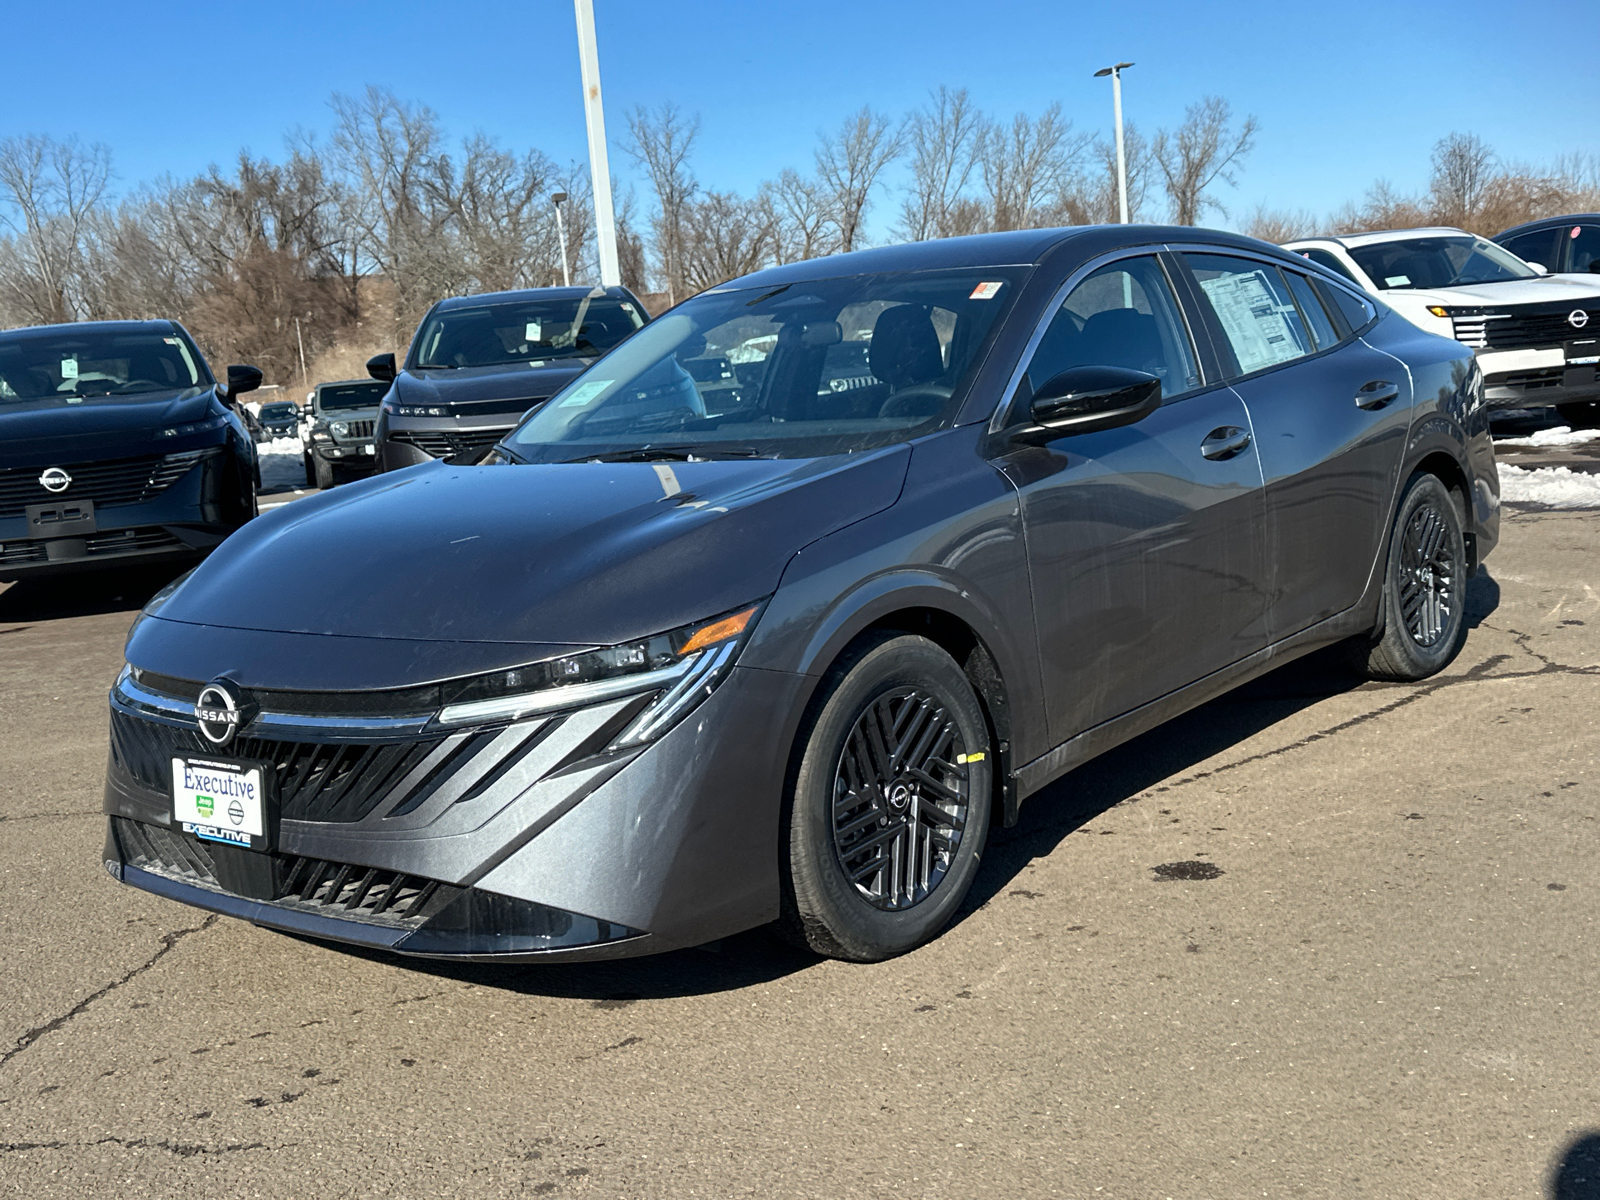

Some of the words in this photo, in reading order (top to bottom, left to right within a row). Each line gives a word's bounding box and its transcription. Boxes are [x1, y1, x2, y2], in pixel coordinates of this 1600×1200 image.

[194, 707, 238, 722] NISSAN
[183, 766, 254, 800] Executive
[198, 797, 212, 807] Jeep
[182, 822, 251, 844] EXECUTIVE
